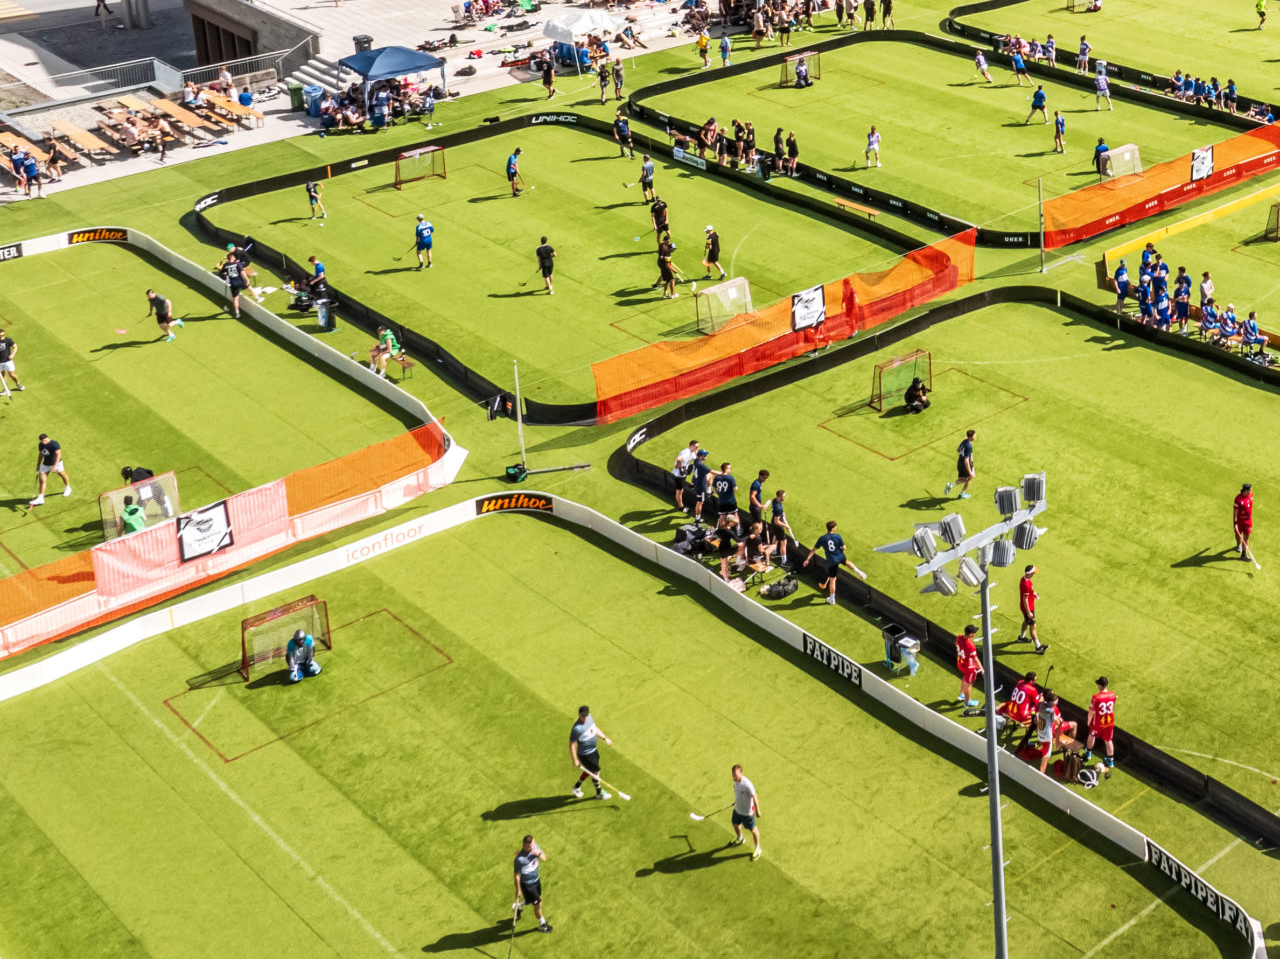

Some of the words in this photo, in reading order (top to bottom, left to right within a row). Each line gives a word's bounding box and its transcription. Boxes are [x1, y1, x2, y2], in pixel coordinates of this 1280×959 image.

[531, 115, 578, 124] UNIHOC
[71, 228, 127, 244] unihoc
[627, 427, 647, 452] OC
[716, 481, 729, 492] 99
[481, 494, 553, 513] unihoc
[346, 523, 425, 563] iconfloor
[827, 539, 836, 552] 8
[805, 635, 828, 668] FAT
[829, 651, 861, 686] PIPE
[1011, 687, 1026, 704] 80
[1098, 701, 1114, 715] 33
[1150, 842, 1179, 882] FAT
[1180, 868, 1217, 913] PIPE
